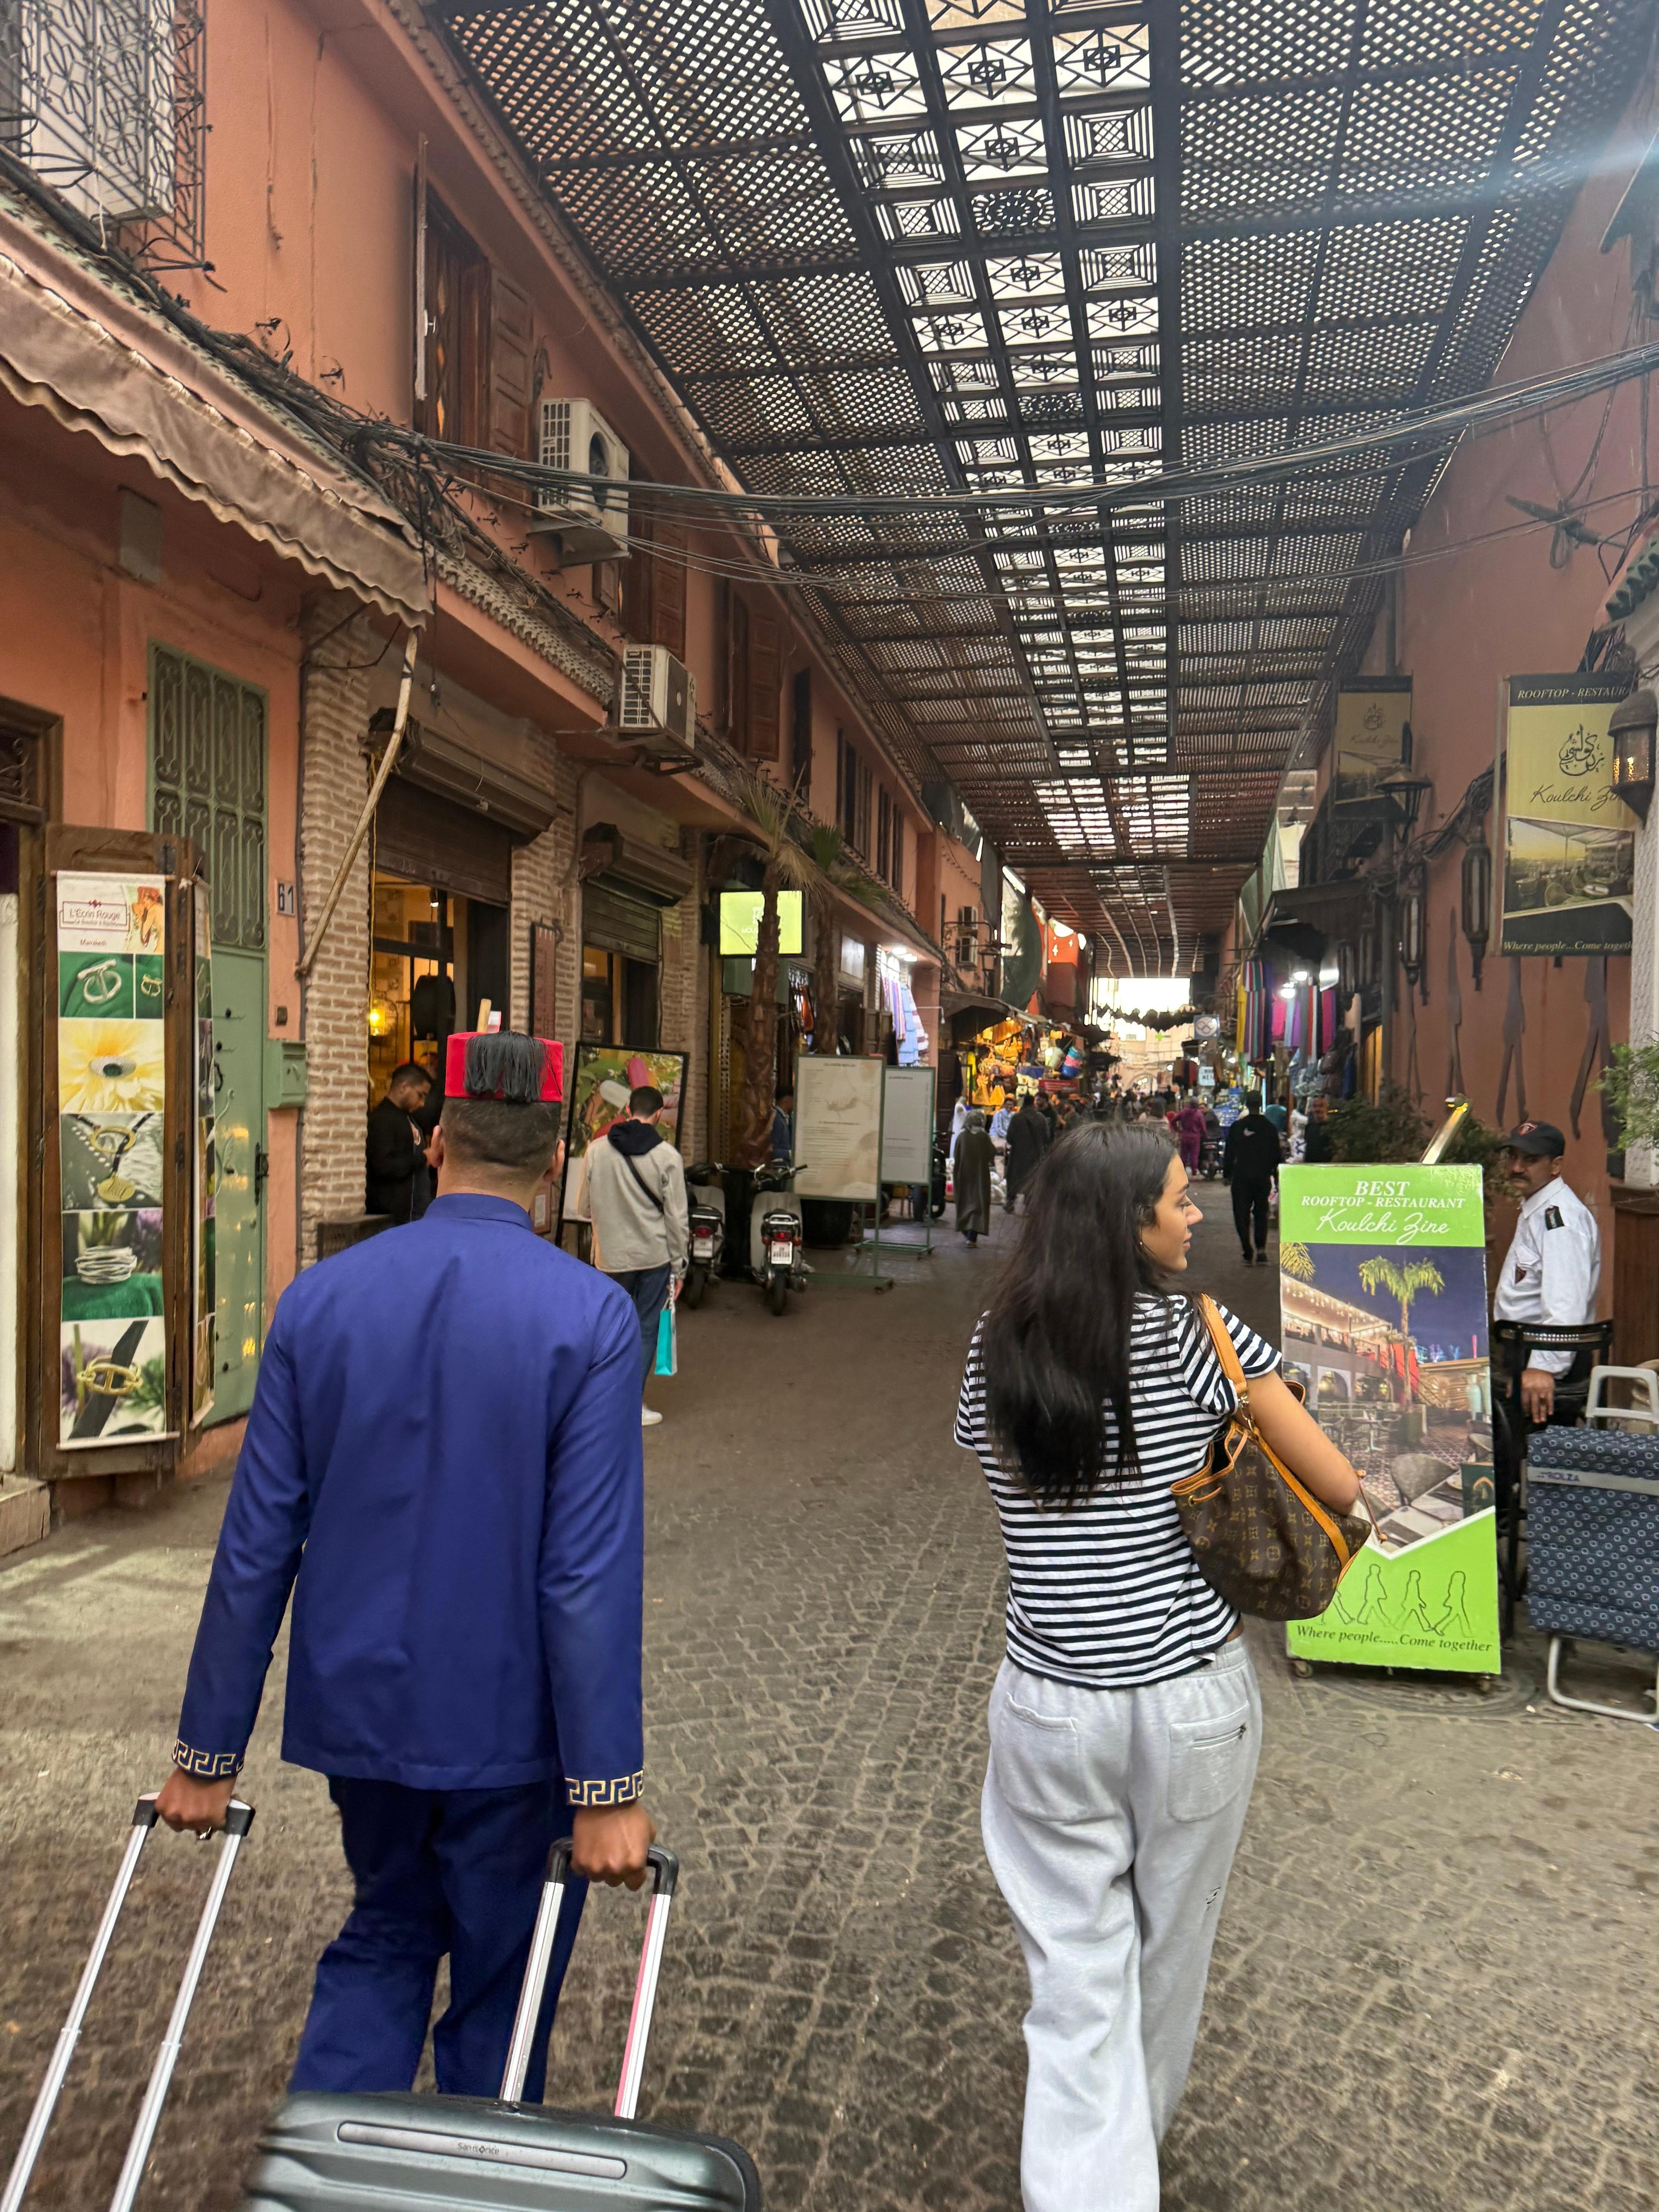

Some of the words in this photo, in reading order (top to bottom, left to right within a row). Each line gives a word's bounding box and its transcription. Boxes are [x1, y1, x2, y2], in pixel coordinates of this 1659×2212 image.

[1517, 688, 1569, 700] ROOFTOP
[1530, 784, 1591, 803] Koulchi
[278, 883, 294, 914] 61
[1355, 1180, 1410, 1197] BEST
[1301, 1195, 1365, 1207] ROOFTOP
[1376, 1197, 1466, 1209] RESTAURANT
[1316, 1208, 1397, 1233] Koulchi
[1396, 1212, 1449, 1246] Zine
[1297, 1625, 1336, 1640] Where
[1439, 1639, 1492, 1652] together
